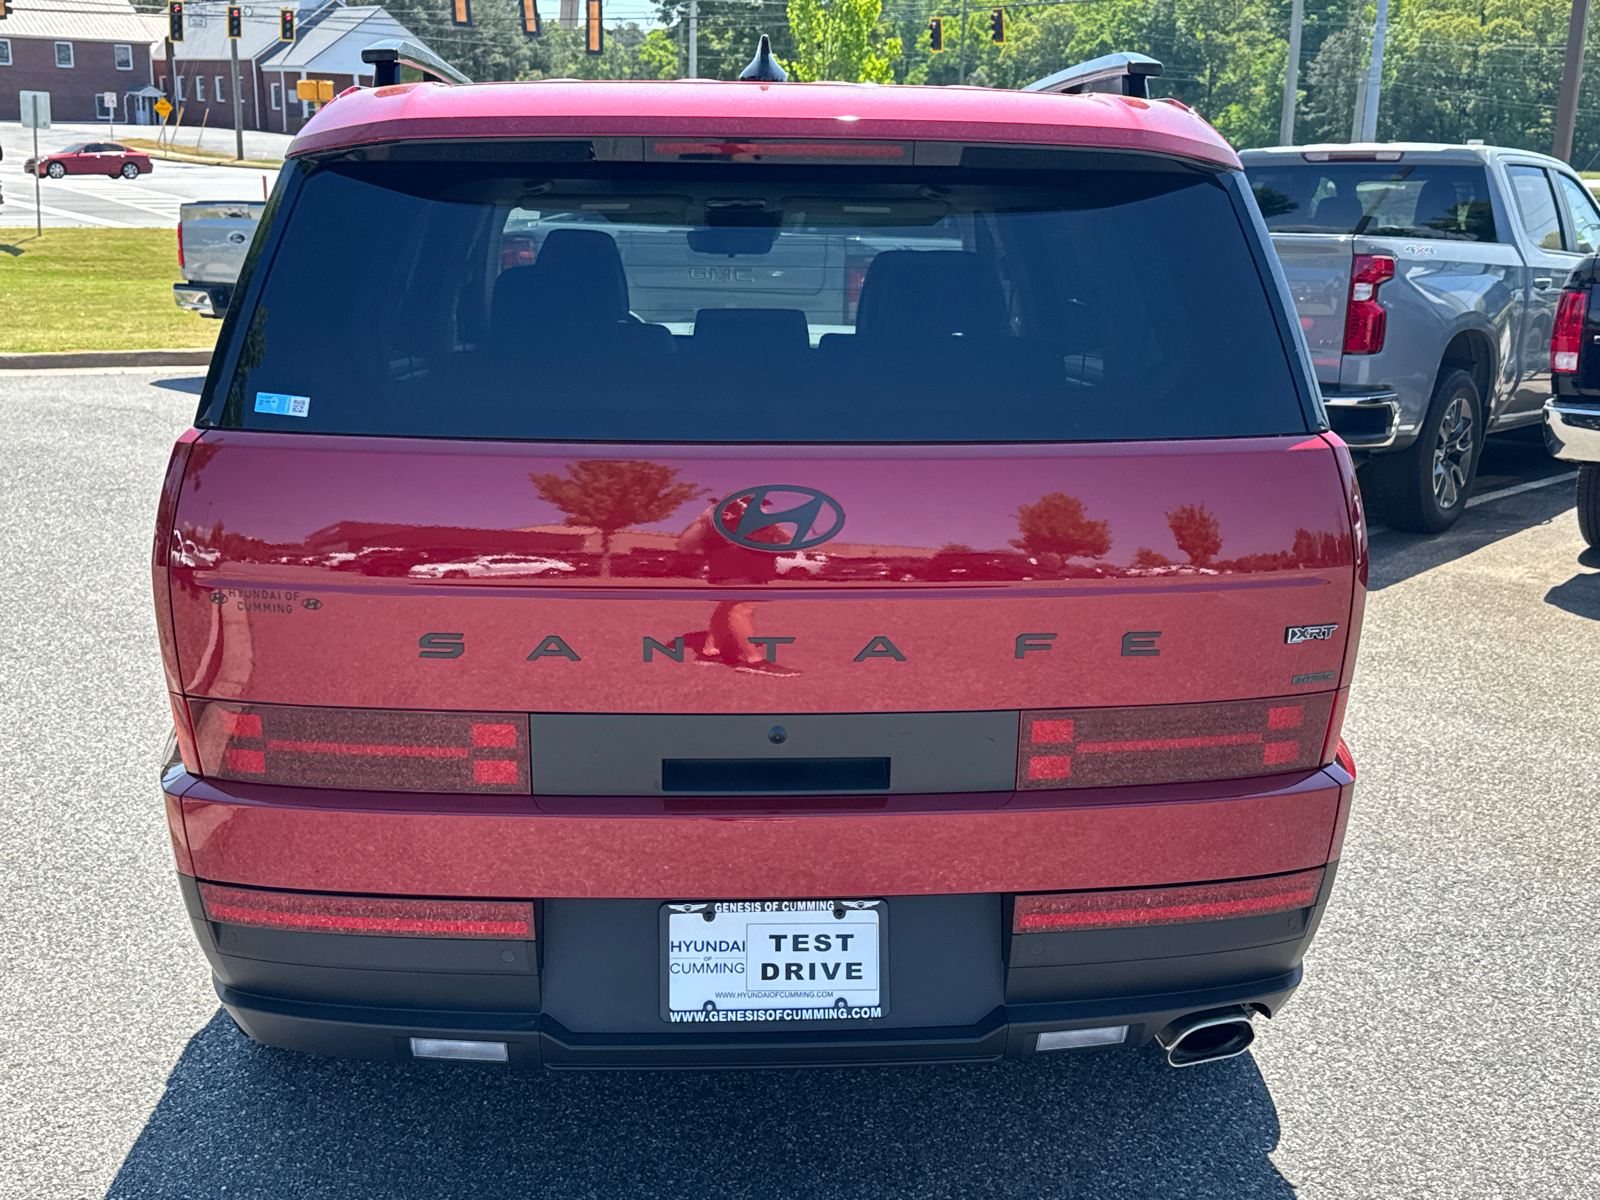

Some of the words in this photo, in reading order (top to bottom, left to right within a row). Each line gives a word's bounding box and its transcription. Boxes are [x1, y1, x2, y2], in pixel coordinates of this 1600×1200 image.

[689, 266, 756, 282] GMC
[228, 588, 281, 600] HYUNDAI
[284, 591, 300, 601] OF
[236, 601, 293, 614] CUMMING
[1286, 624, 1338, 643] XRT
[714, 902, 762, 913] GENESIS
[764, 901, 780, 912] OF
[781, 900, 835, 912] CUMMING
[670, 940, 746, 953] HYUNDAI
[768, 933, 855, 952] TEST
[669, 962, 746, 975] CUMMING
[760, 962, 864, 981] DRIVE
[714, 991, 834, 999] WWW.HYUNDAIOFCUMMING.COM
[669, 1007, 882, 1023] WWW.GENESISOFCUMMING.COM
